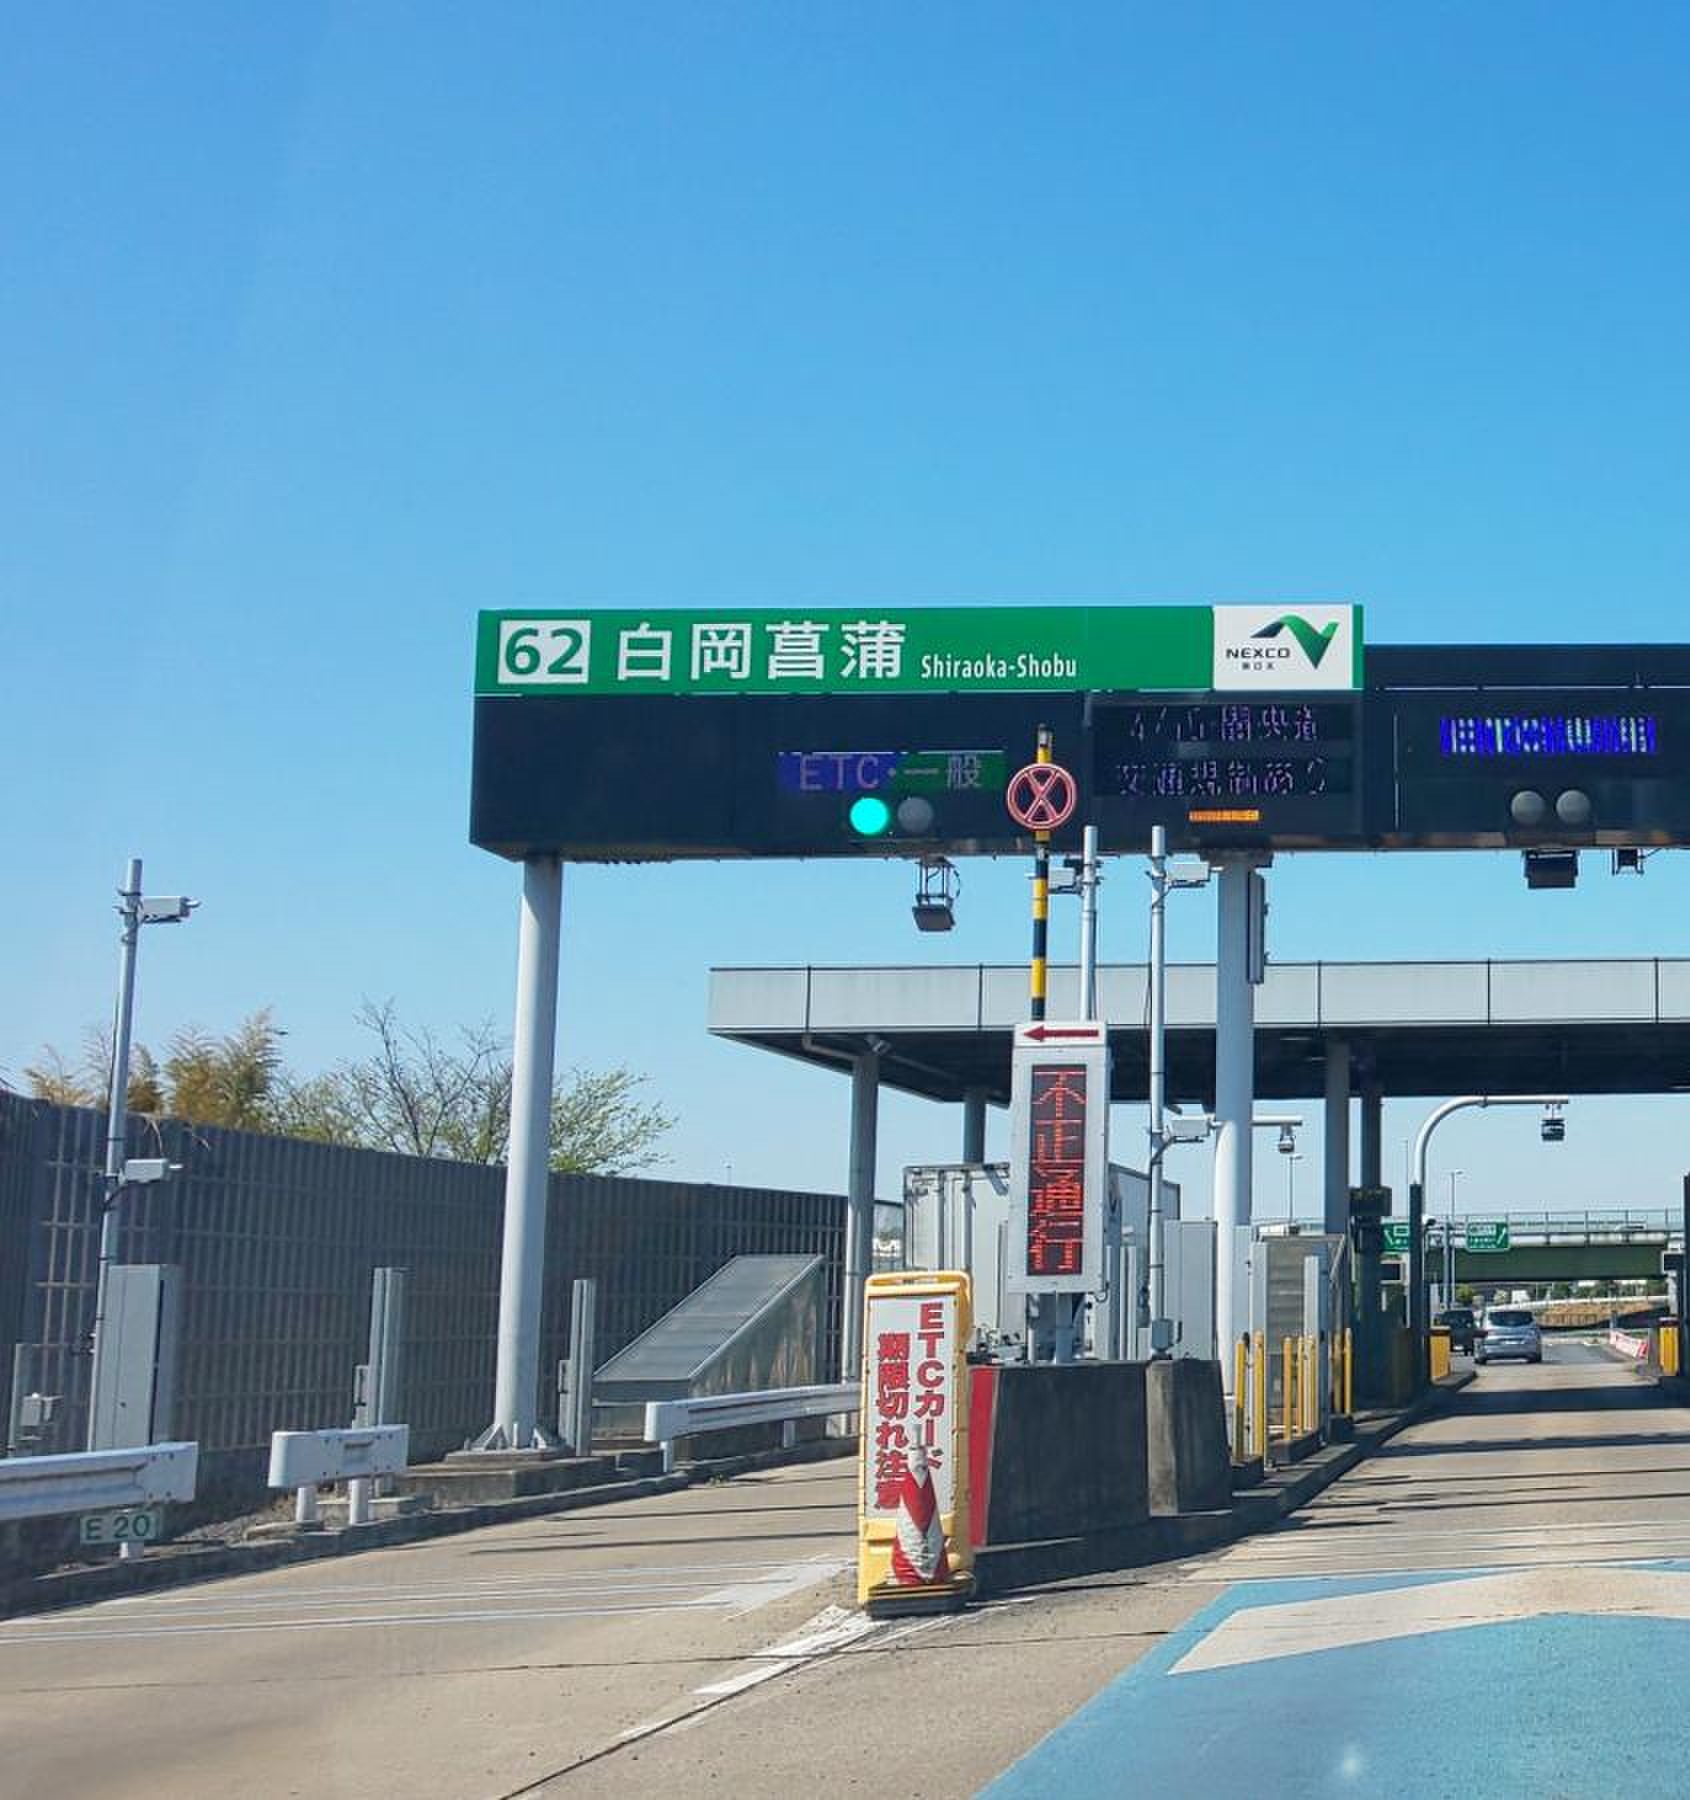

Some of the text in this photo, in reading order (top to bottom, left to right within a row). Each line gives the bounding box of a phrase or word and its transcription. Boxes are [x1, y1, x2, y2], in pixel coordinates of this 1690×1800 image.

[504, 620, 1078, 681] 62 白岡菖蒲 Shiraoka-Shobu
[1225, 647, 1291, 660] NEXCO
[1028, 1070, 1087, 1270] 不正通行
